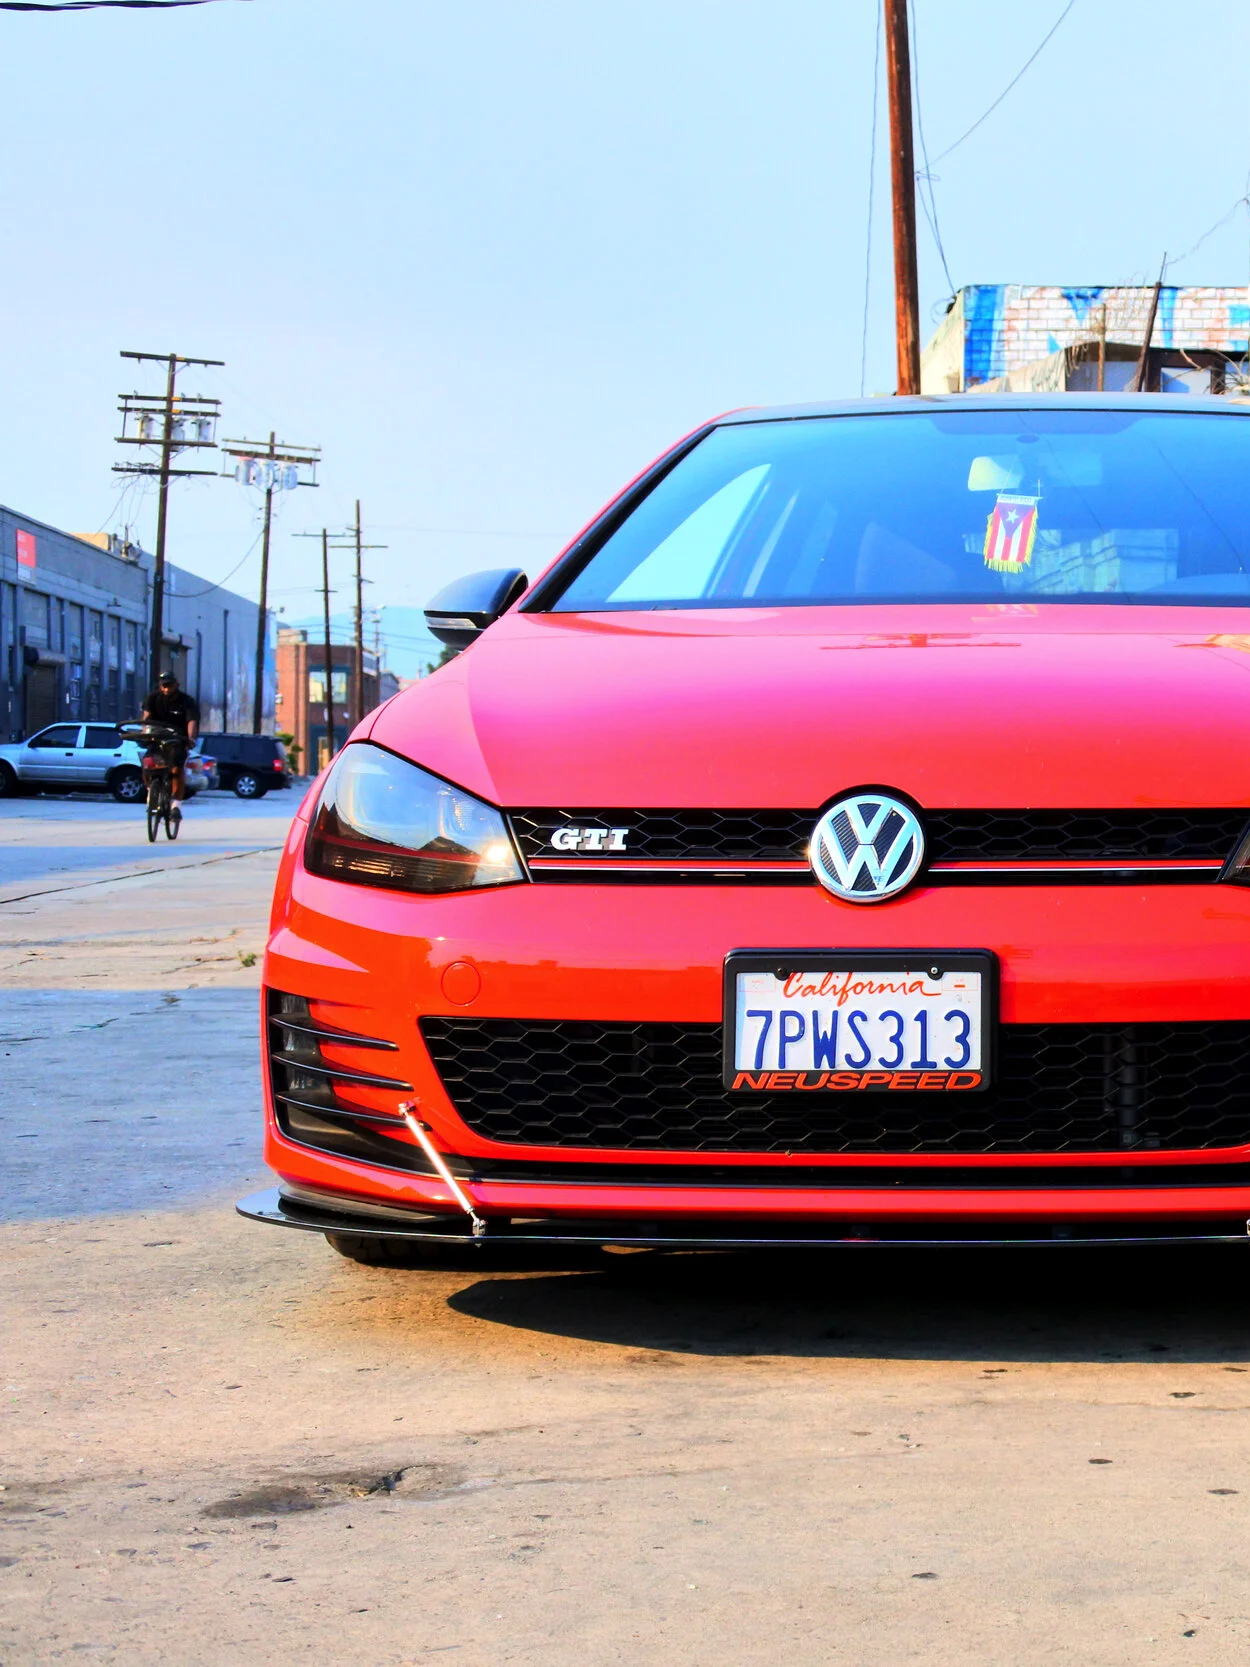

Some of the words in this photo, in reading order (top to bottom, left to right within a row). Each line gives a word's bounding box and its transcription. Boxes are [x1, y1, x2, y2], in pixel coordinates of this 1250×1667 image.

[550, 828, 629, 850] GTI
[811, 795, 924, 902] VW
[782, 971, 942, 1007] California
[746, 1009, 971, 1069] 7PWS313
[731, 1072, 982, 1091] NEUSPEED
